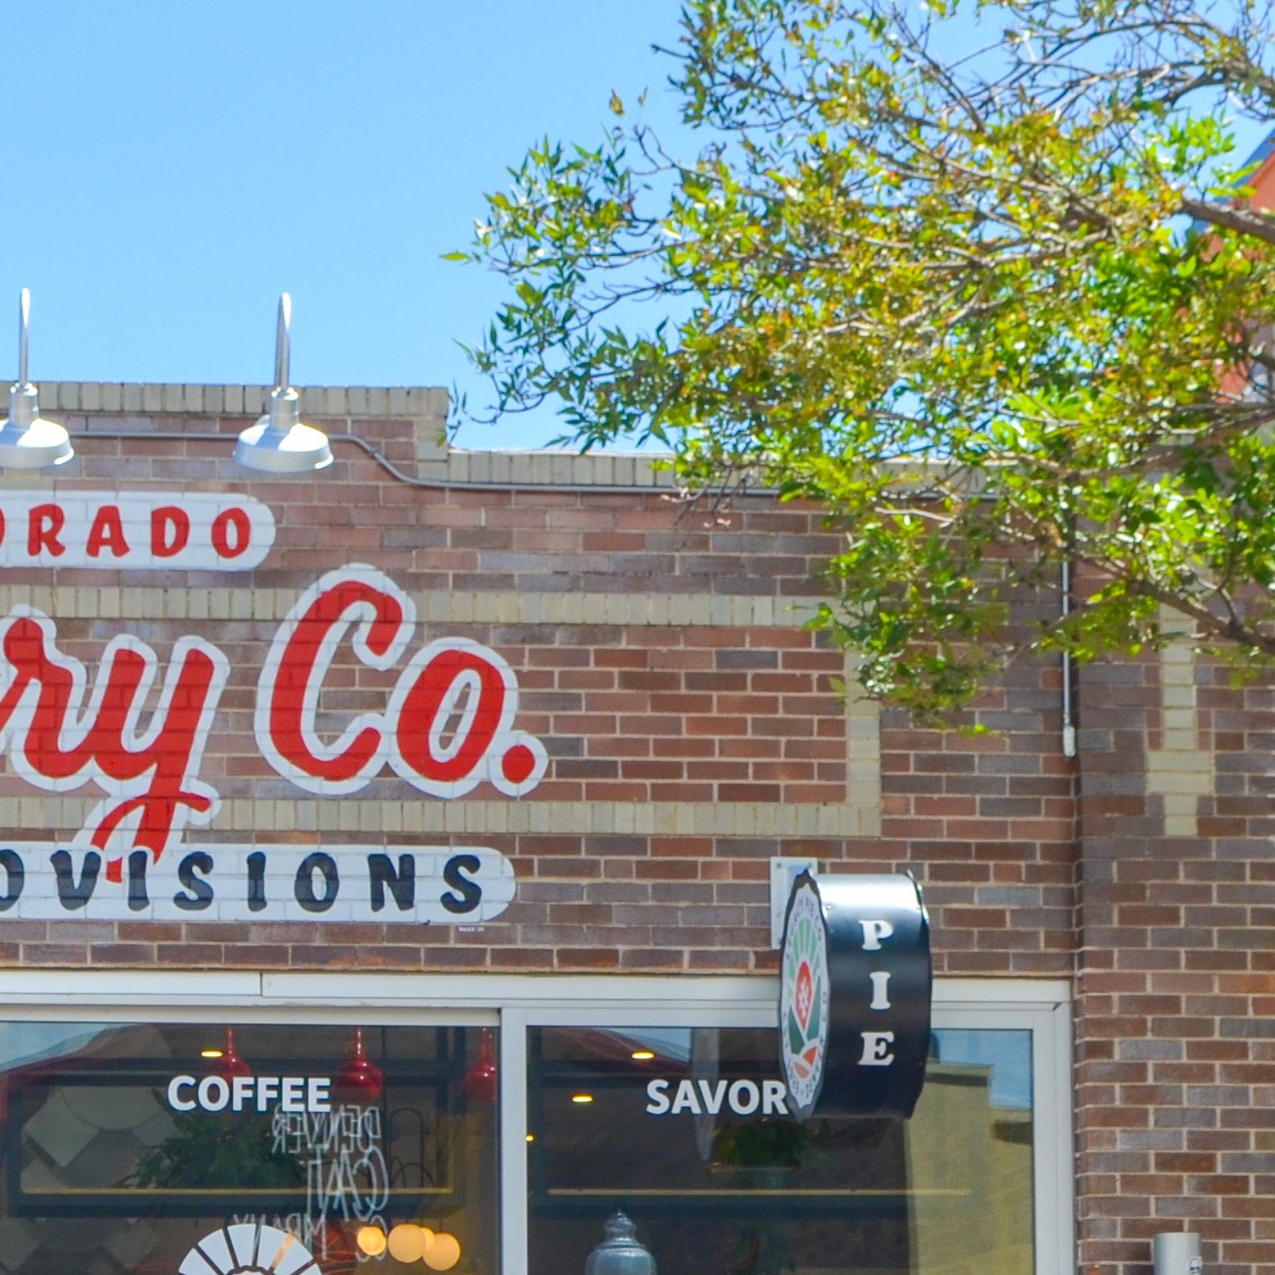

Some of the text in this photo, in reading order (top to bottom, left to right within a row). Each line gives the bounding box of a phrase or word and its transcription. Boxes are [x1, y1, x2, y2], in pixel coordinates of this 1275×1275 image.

[269, 581, 535, 784] Co.
[857, 919, 896, 1067] PIE
[168, 1075, 331, 1112] COFFEE
[646, 1078, 788, 1114] SAVOR
